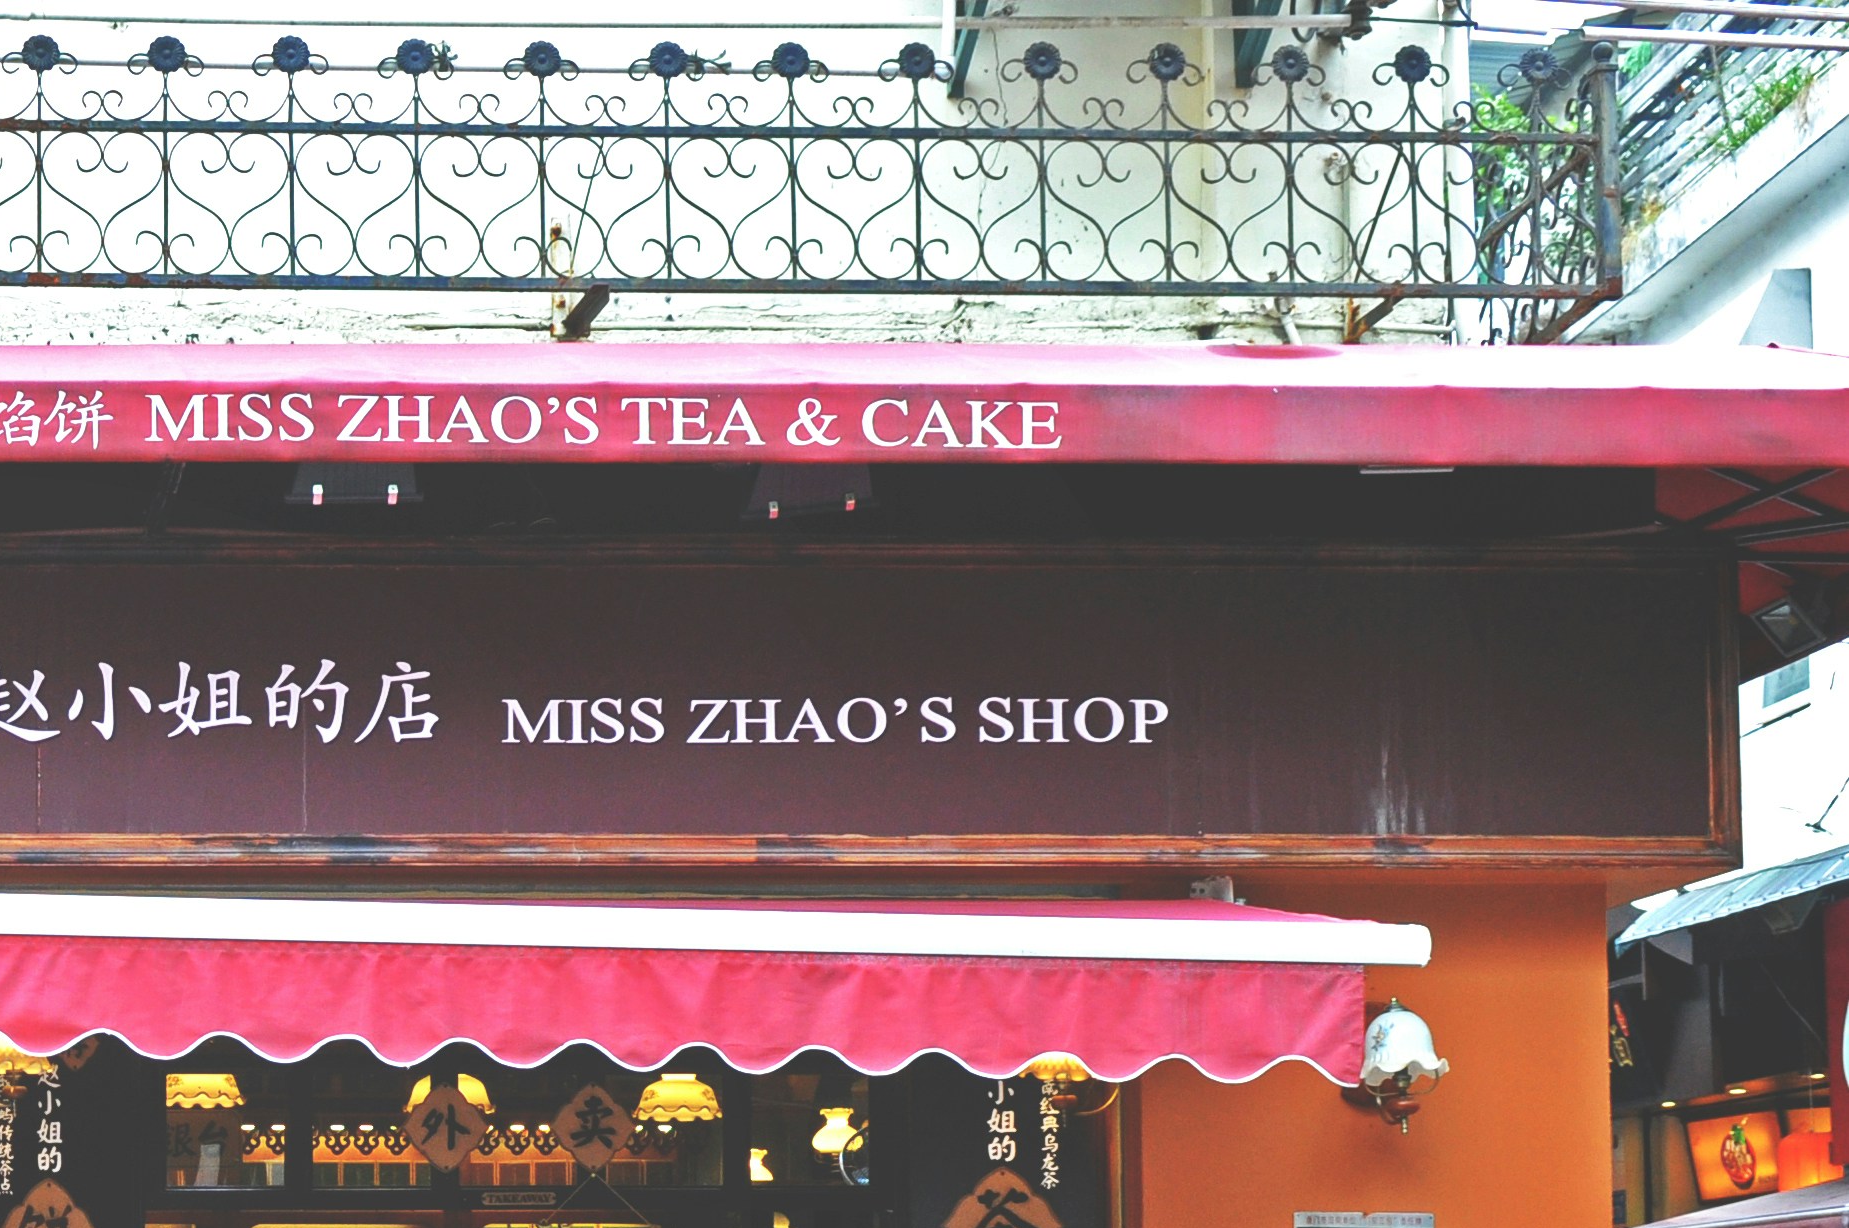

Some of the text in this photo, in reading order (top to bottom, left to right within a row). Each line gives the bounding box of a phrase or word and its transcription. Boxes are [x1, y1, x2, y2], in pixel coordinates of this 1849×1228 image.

[144, 394, 315, 442] MISS
[337, 395, 599, 445] ZHAO'S
[622, 398, 766, 446] TEA
[787, 398, 841, 447] &
[862, 399, 1062, 449] CAKE
[502, 698, 664, 743] MISS
[687, 697, 956, 744] ZHAO'S
[979, 697, 1169, 743] SHOP
[421, 1096, 614, 1151] 外 卖
